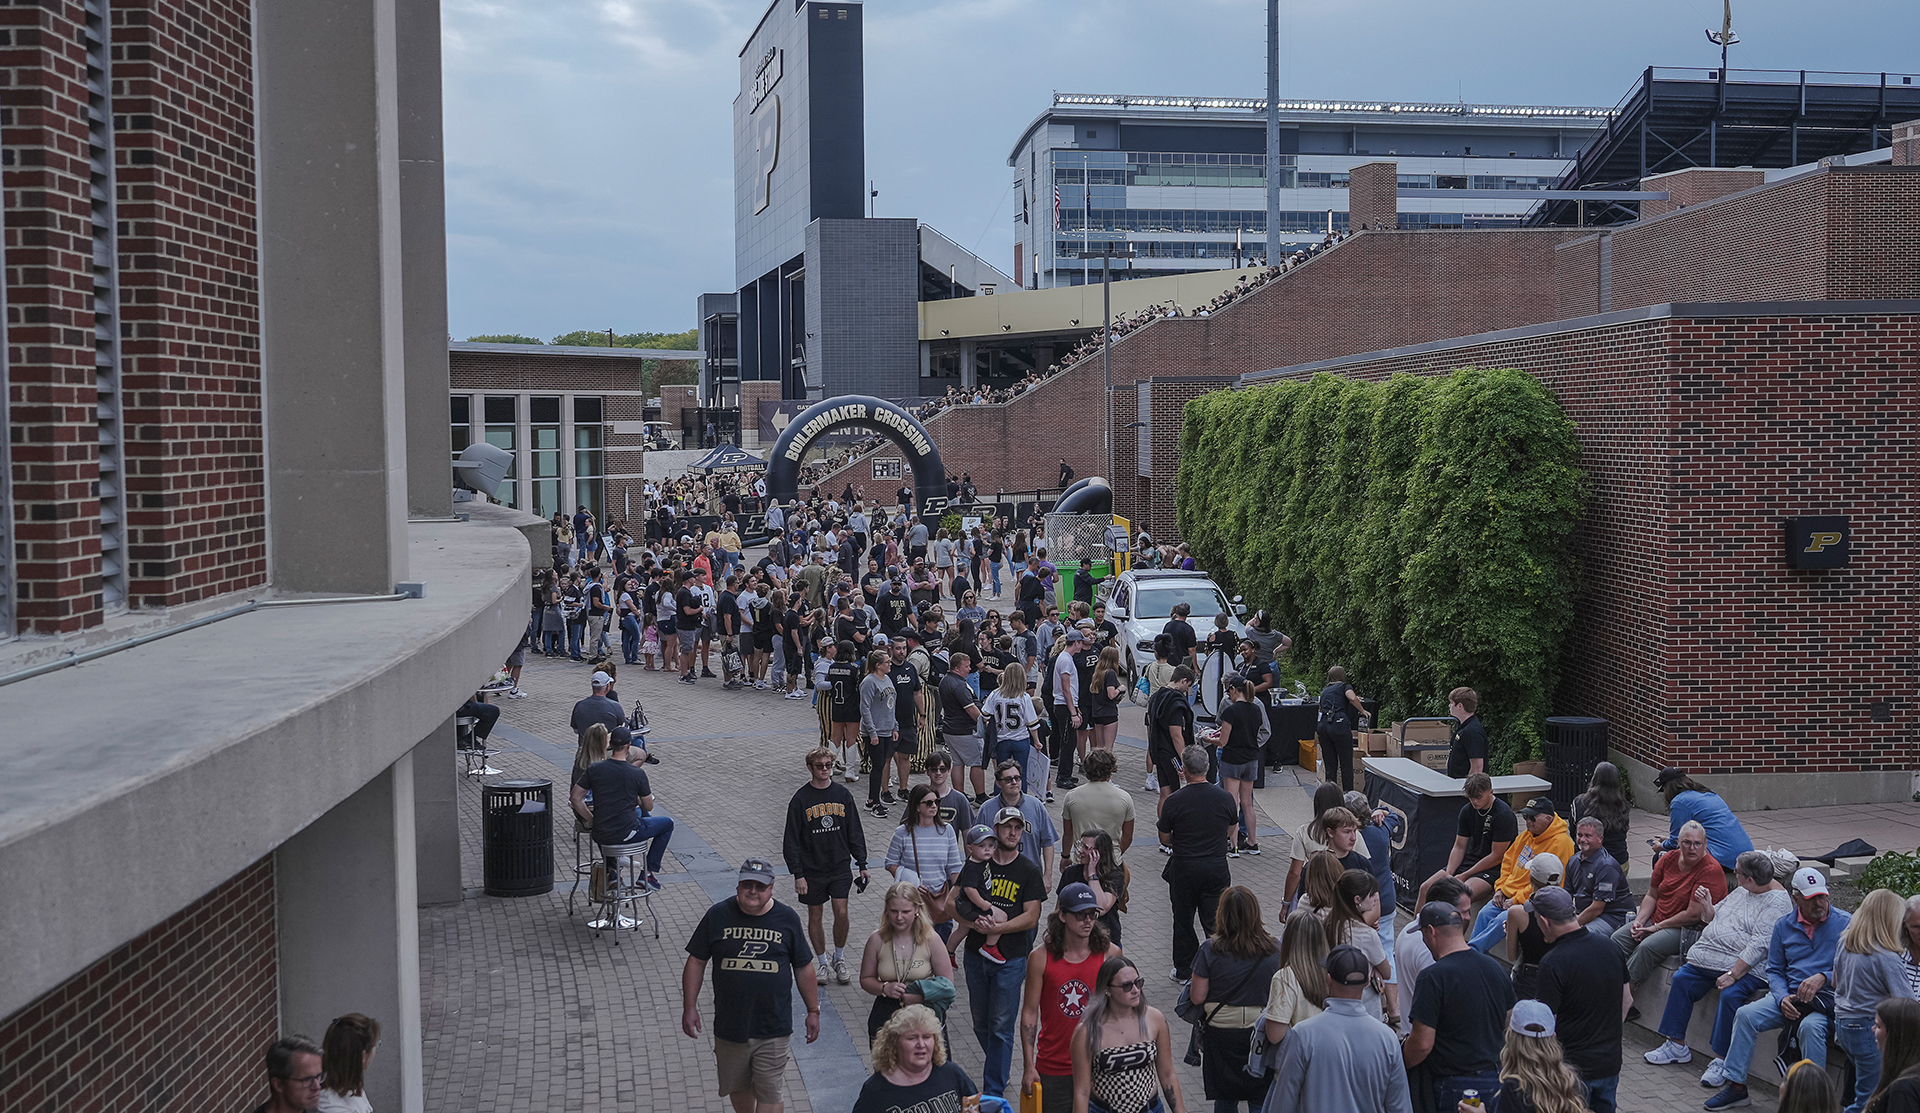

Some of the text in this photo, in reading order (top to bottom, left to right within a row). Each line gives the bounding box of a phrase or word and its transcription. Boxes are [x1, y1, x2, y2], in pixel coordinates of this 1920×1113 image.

[785, 404, 932, 462] BOILERMAKER CROSSING
[720, 453, 748, 464] P
[712, 466, 735, 474] PURDUE
[736, 464, 765, 472] FOOTBALL
[923, 497, 949, 516] P
[1804, 532, 1842, 552] P
[983, 655, 1000, 667] RDUE
[1086, 655, 1099, 667] P
[834, 680, 845, 704] 1
[995, 703, 1021, 732] 15
[805, 802, 846, 822] PURDUE
[991, 878, 1020, 903] CHIE
[722, 927, 783, 944] PURDUE
[737, 941, 769, 958] P
[726, 960, 773, 970] DAD
[1060, 981, 1088, 994] ORANGE
[1060, 1002, 1087, 1016] BEACH
[1104, 1049, 1147, 1075] P
[886, 1090, 961, 1113] RDUE
